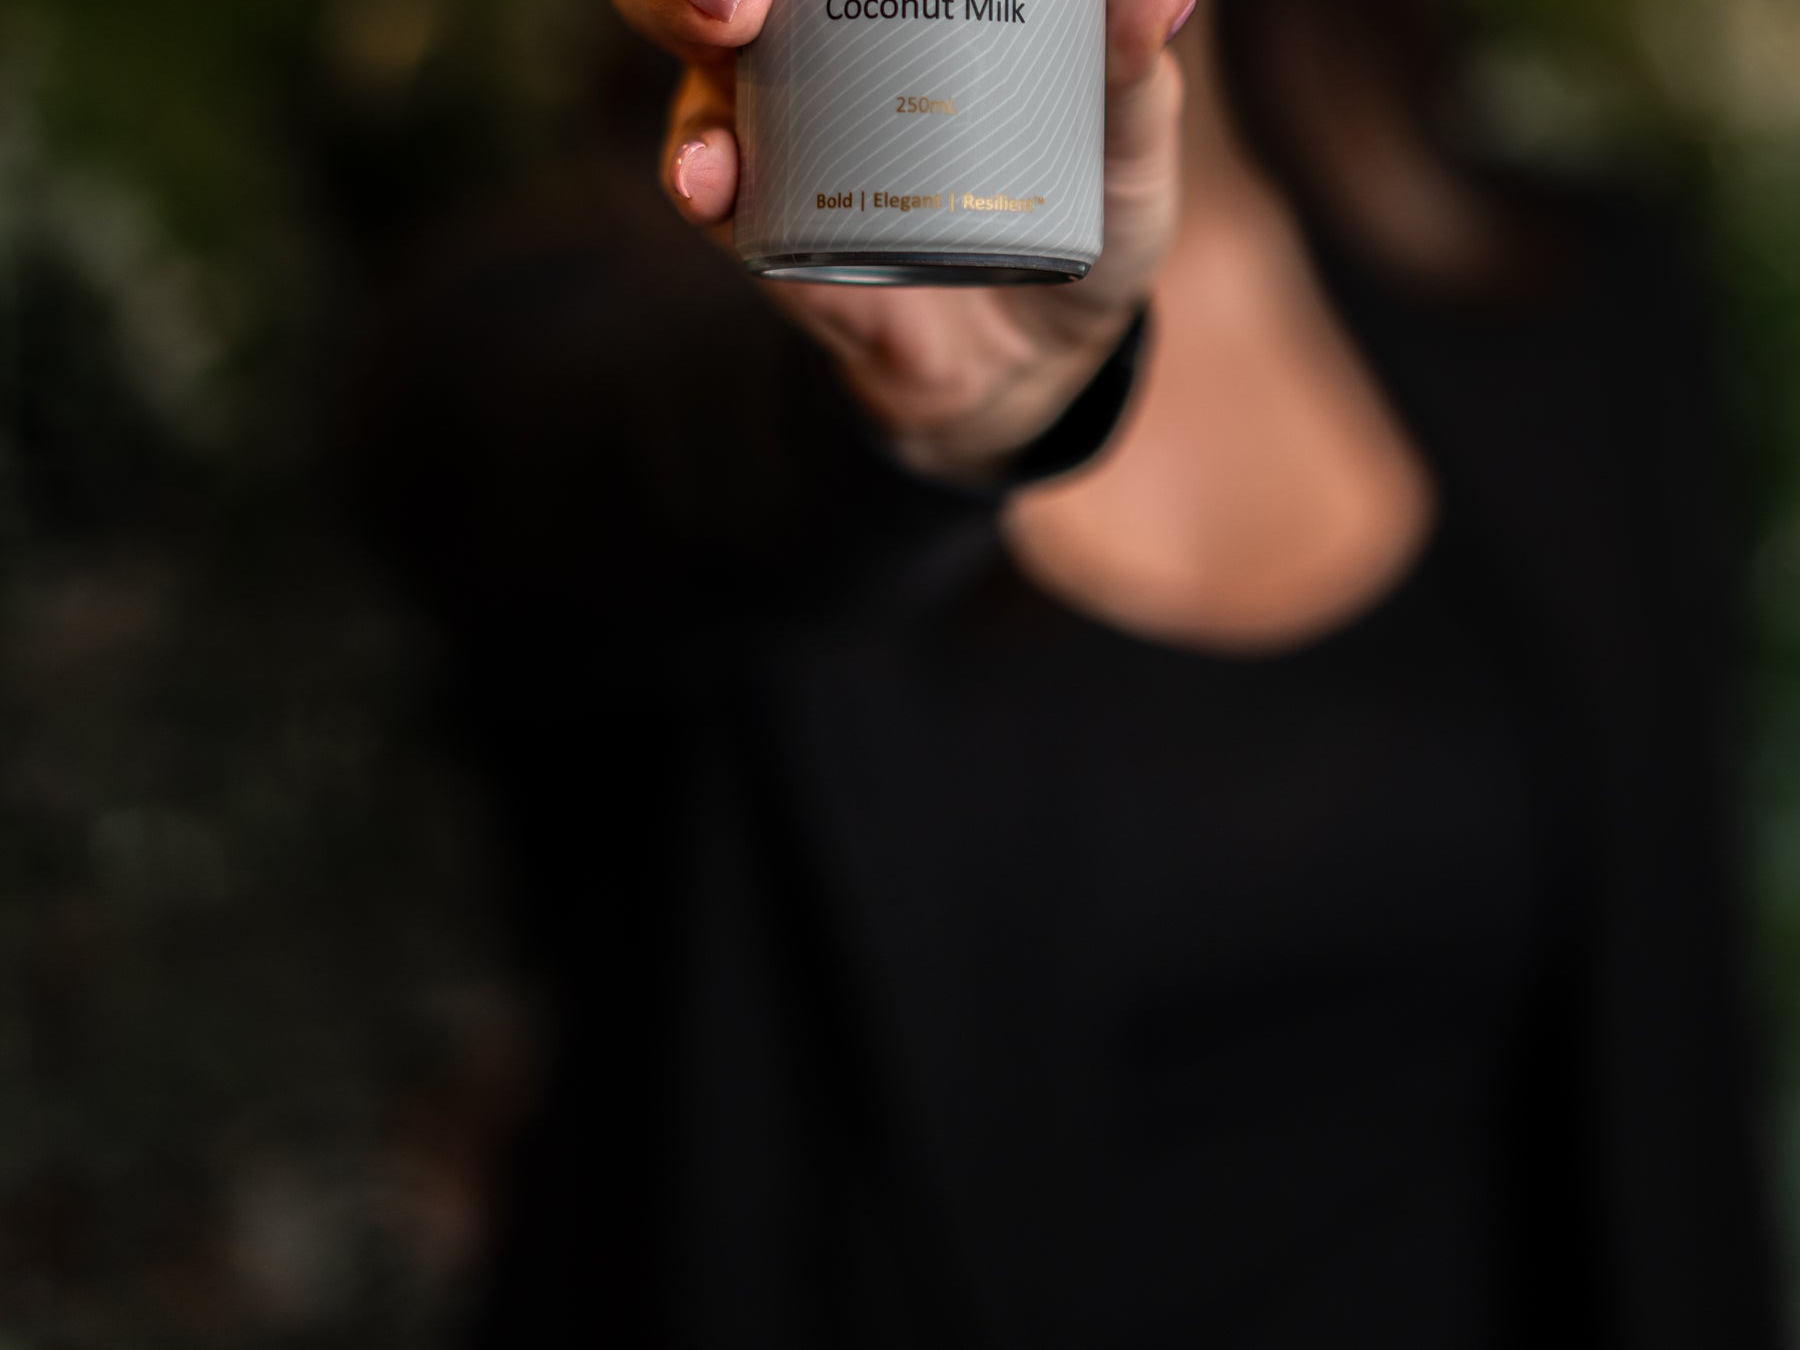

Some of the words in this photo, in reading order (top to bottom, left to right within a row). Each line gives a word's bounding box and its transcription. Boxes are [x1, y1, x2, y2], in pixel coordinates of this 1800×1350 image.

[896, 96, 958, 115] 250mL
[816, 191, 852, 209] Bold
[873, 191, 941, 212] Elegant
